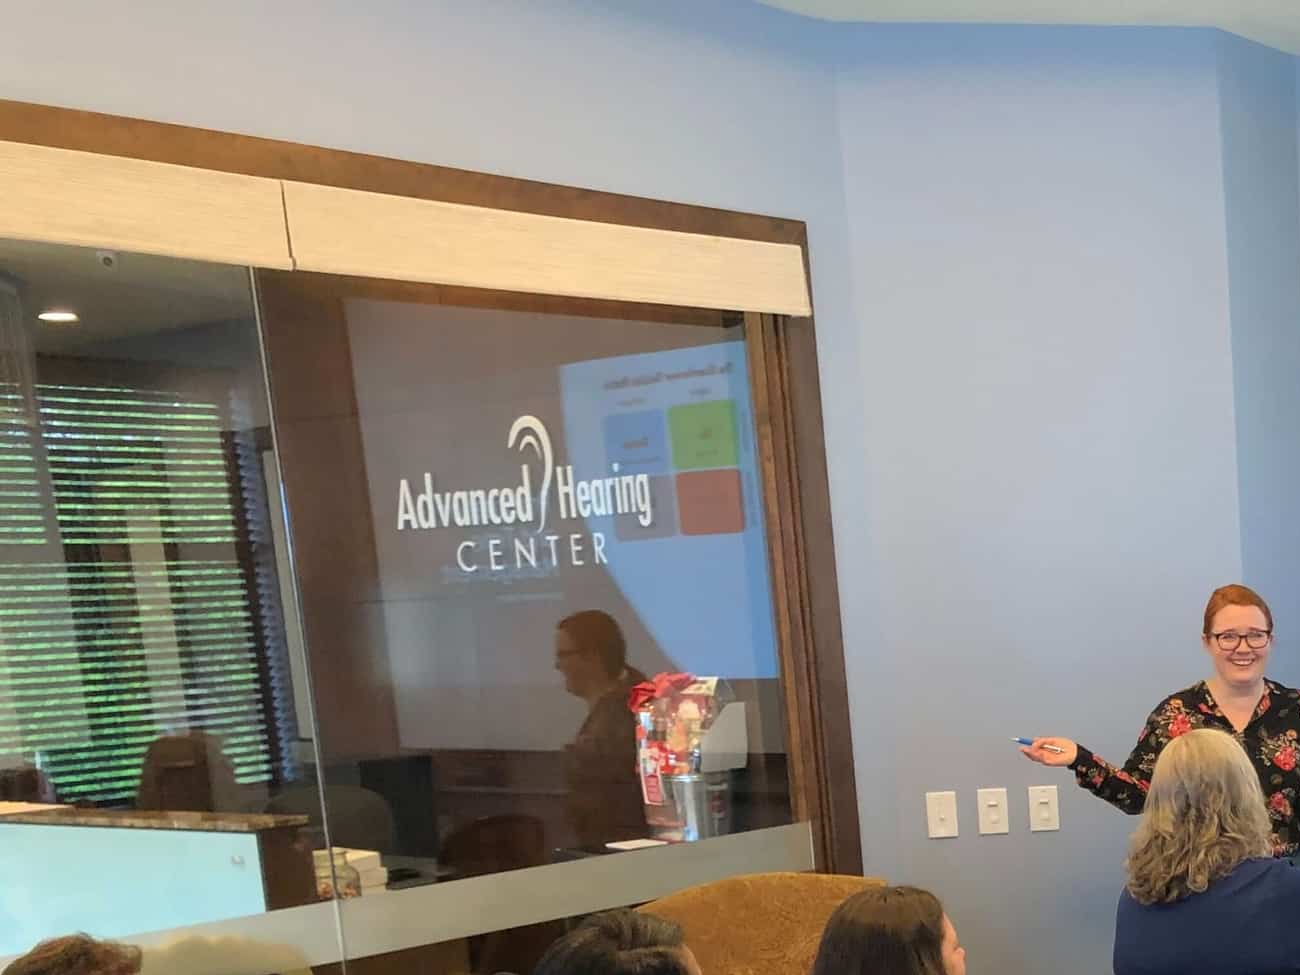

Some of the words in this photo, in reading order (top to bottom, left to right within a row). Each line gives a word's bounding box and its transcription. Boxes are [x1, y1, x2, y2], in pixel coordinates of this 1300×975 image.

[397, 464, 533, 530] Advanced
[555, 463, 652, 528] Hearing
[456, 532, 609, 573] CENTER
